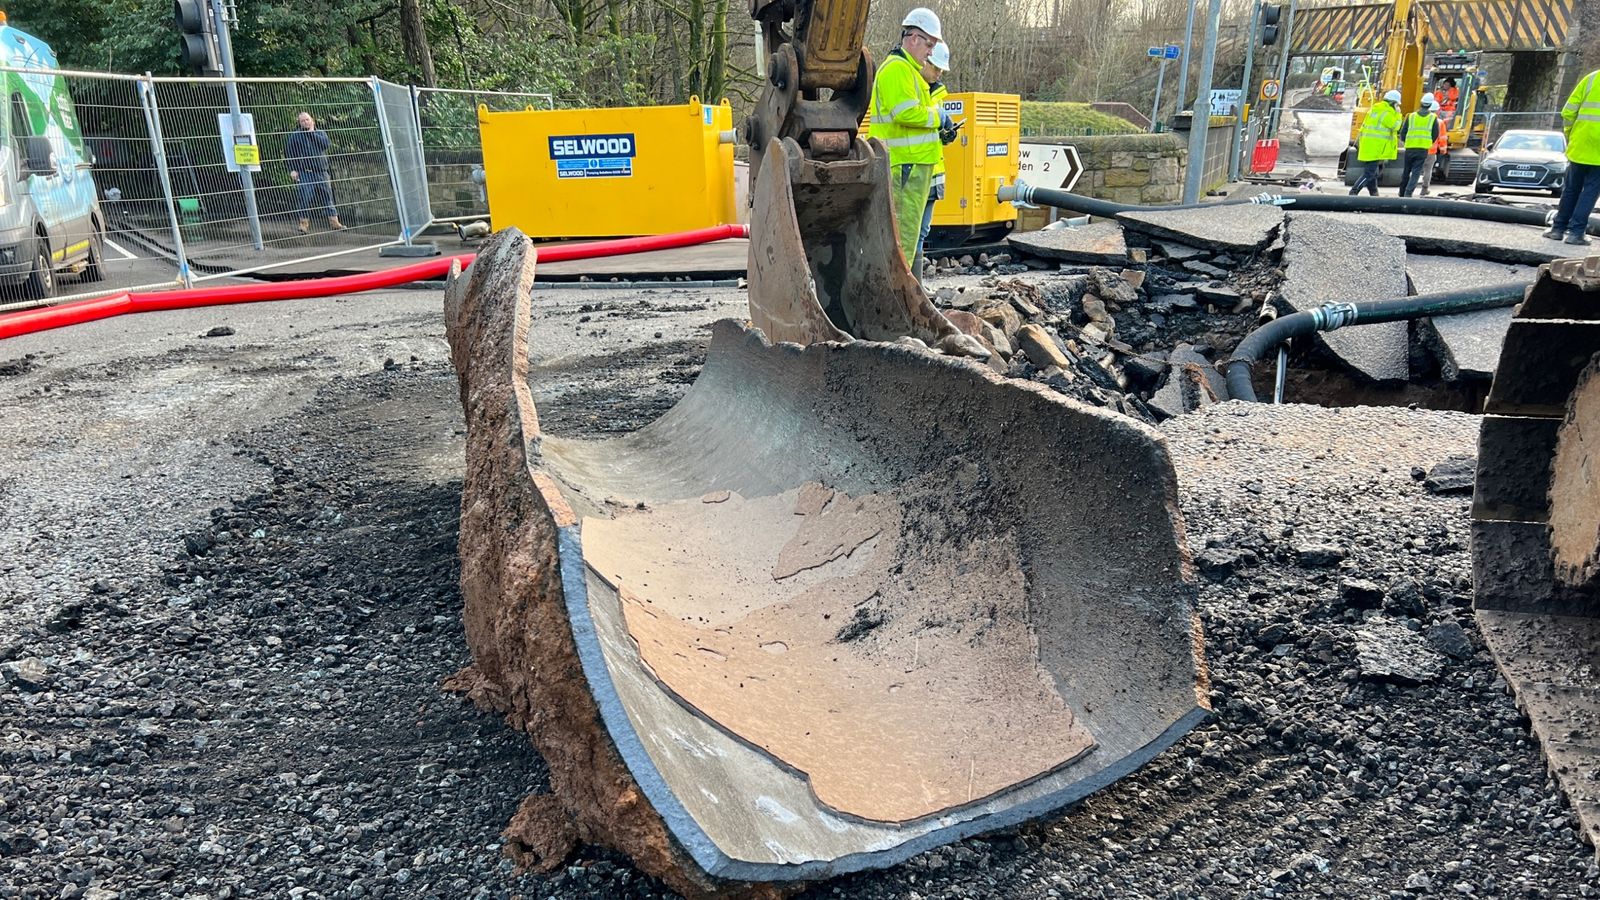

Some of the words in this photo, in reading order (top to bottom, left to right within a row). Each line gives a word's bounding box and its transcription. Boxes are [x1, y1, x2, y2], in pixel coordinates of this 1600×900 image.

[553, 138, 631, 155] SELWOOD
[987, 145, 1008, 154] SELWOOD
[1051, 150, 1058, 159] 7
[1043, 162, 1050, 172] 2
